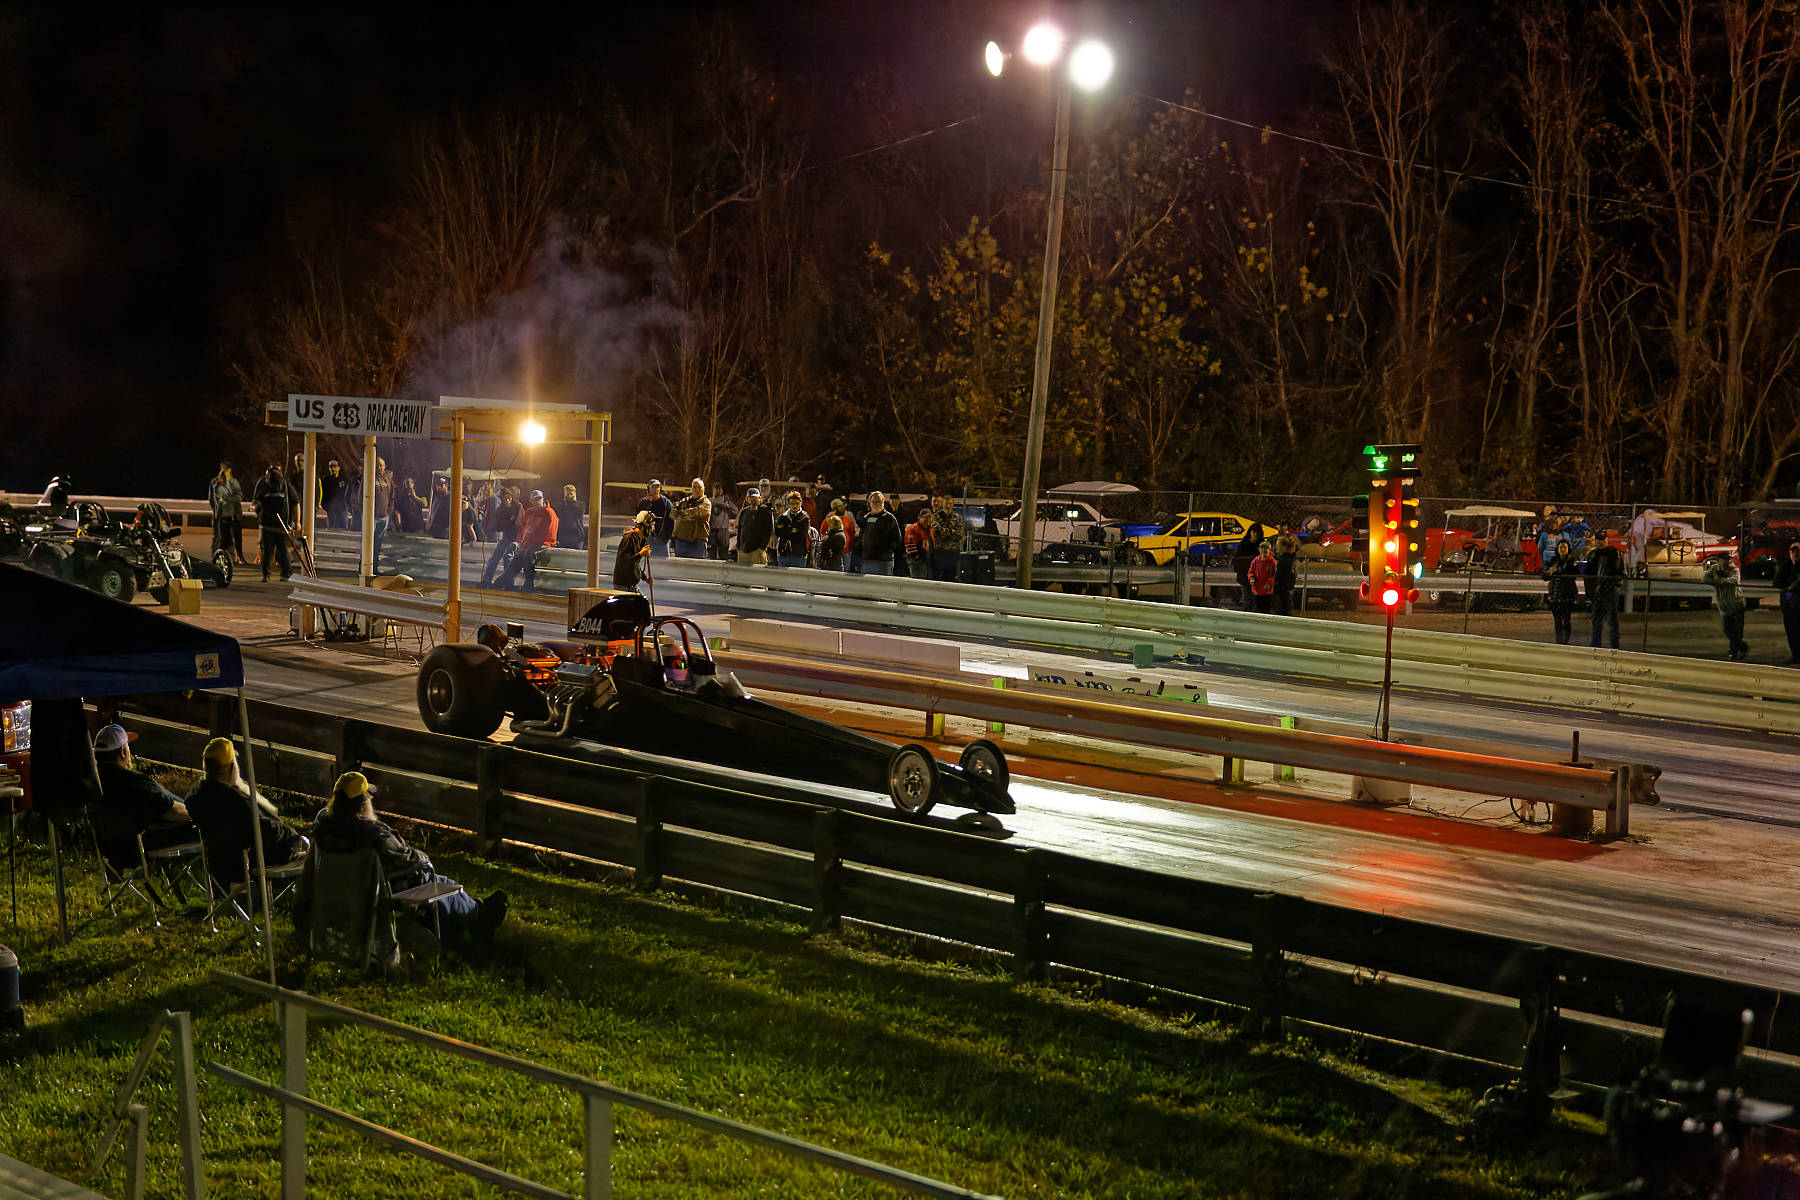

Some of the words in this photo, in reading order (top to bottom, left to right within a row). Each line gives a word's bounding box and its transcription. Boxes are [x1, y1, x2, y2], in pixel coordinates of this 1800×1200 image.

[295, 399, 325, 419] US
[334, 407, 358, 425] 43
[366, 403, 387, 432] DRAG
[388, 404, 427, 434] RACEWAY
